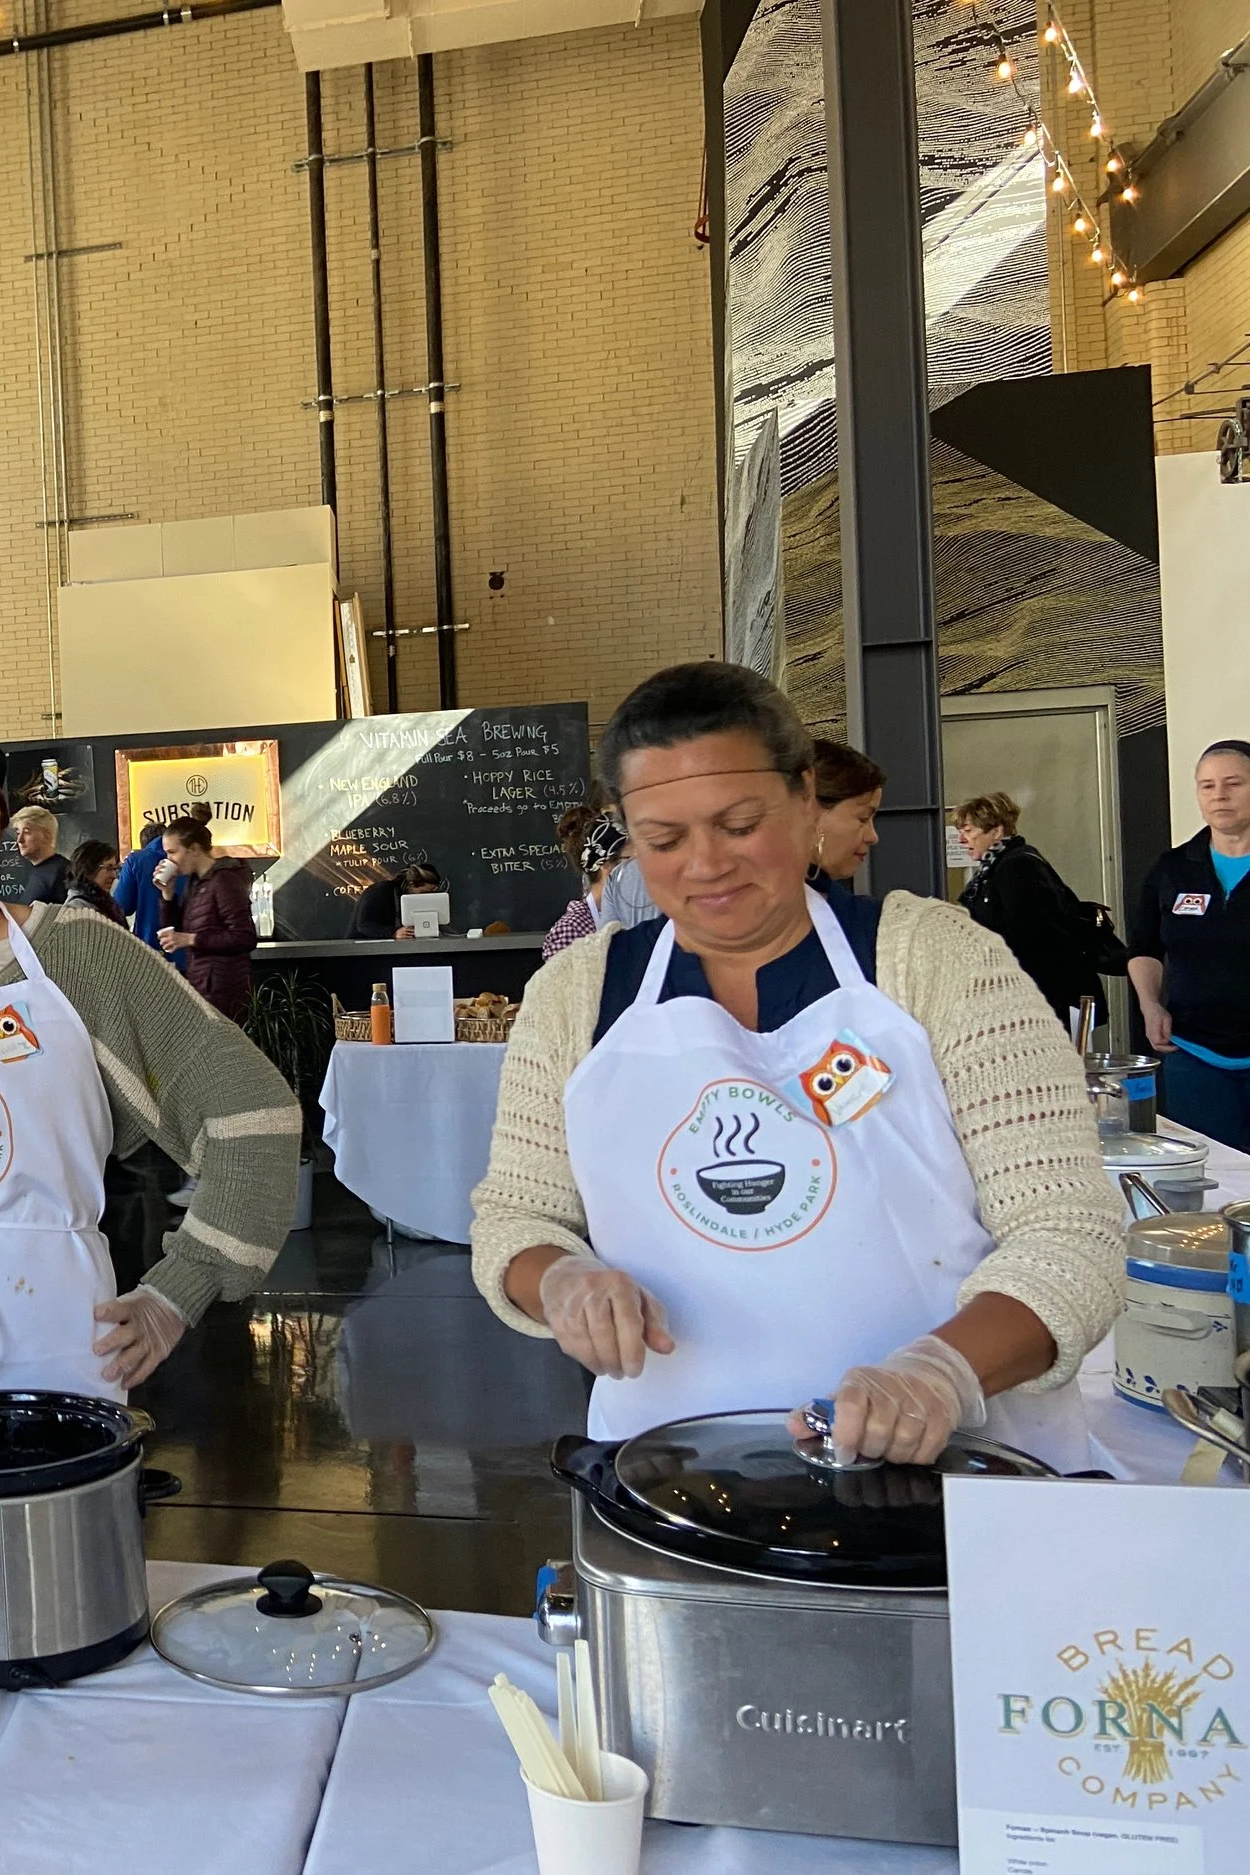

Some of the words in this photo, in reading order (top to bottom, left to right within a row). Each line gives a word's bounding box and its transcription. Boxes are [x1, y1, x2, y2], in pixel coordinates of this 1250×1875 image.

[360, 730, 430, 749] VITAMIN
[436, 726, 468, 746] SEA
[481, 721, 548, 742] BREWING
[457, 750, 474, 762] $8
[492, 748, 513, 760] 5oz
[544, 743, 560, 755] $5
[330, 778, 358, 791] NEW
[362, 775, 418, 791] ENGLAND
[472, 771, 514, 785] HOPPY
[523, 769, 554, 782] RICE
[492, 786, 538, 800] LAGER
[543, 777, 586, 797] (4.5%)
[347, 793, 370, 809] IPA
[375, 791, 417, 807] (6.8%)
[467, 802, 513, 814] Proceeds
[517, 805, 528, 815] go
[143, 801, 255, 824] SUBSTION
[330, 827, 395, 841] BLUEBERRY
[330, 844, 367, 857] MAPLE
[373, 840, 409, 853] SOUR
[481, 847, 515, 859] EXTRA
[519, 844, 567, 856] SPECIAL
[491, 861, 535, 874] BITTER
[689, 1089, 719, 1134] EMPTY
[728, 1086, 797, 1123] BOWLS
[712, 1180, 744, 1190] Fighting
[745, 1178, 775, 1188] Hunger
[672, 1183, 748, 1239] ROSLINDALE
[764, 1212, 801, 1237] HYDE
[800, 1175, 821, 1212] PARK
[1056, 1628, 1234, 1681] BREAD
[735, 1704, 907, 1744] Cuisinart
[997, 1692, 1248, 1749] FORNA
[1058, 1756, 1242, 1811] COMPANY
